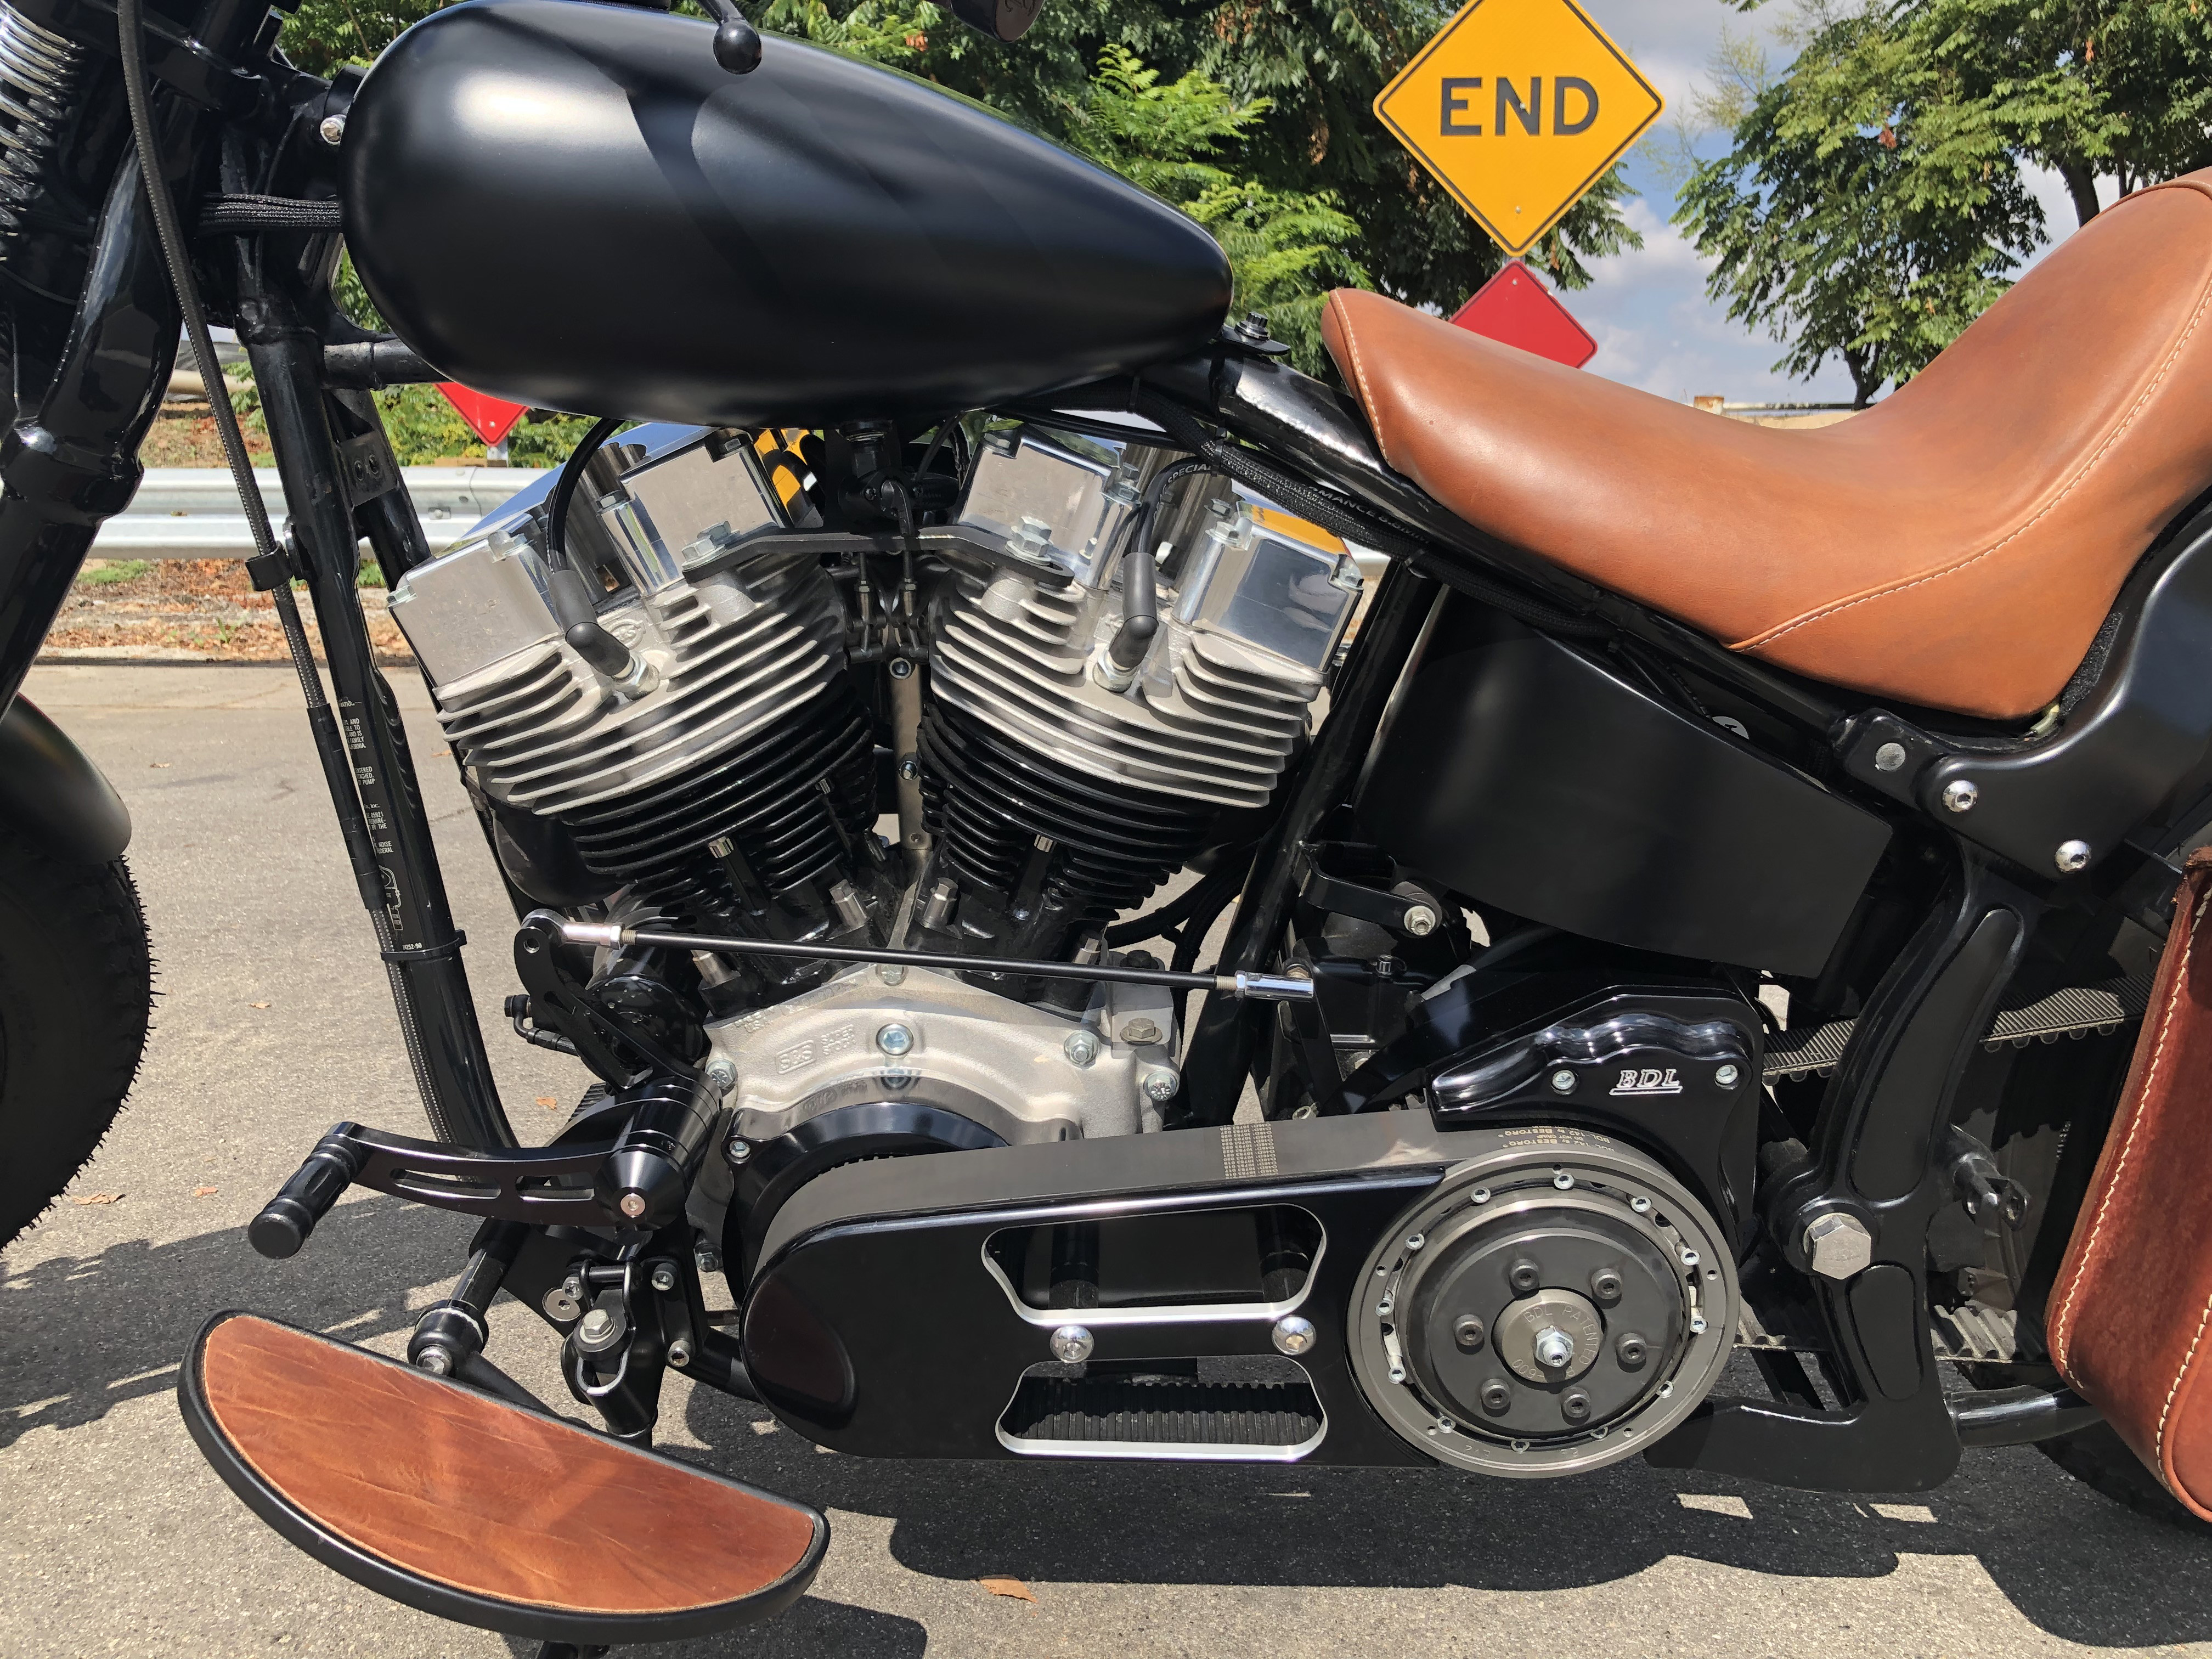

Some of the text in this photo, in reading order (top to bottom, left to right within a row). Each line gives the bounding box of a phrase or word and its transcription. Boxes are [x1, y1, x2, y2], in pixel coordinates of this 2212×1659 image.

[1440, 76, 1599, 136] END
[780, 1045, 812, 1070] S&S
[1616, 1068, 1680, 1088] BDL
[1523, 1306, 1553, 1323] BDL
[1562, 1305, 1599, 1365] PATENTED
